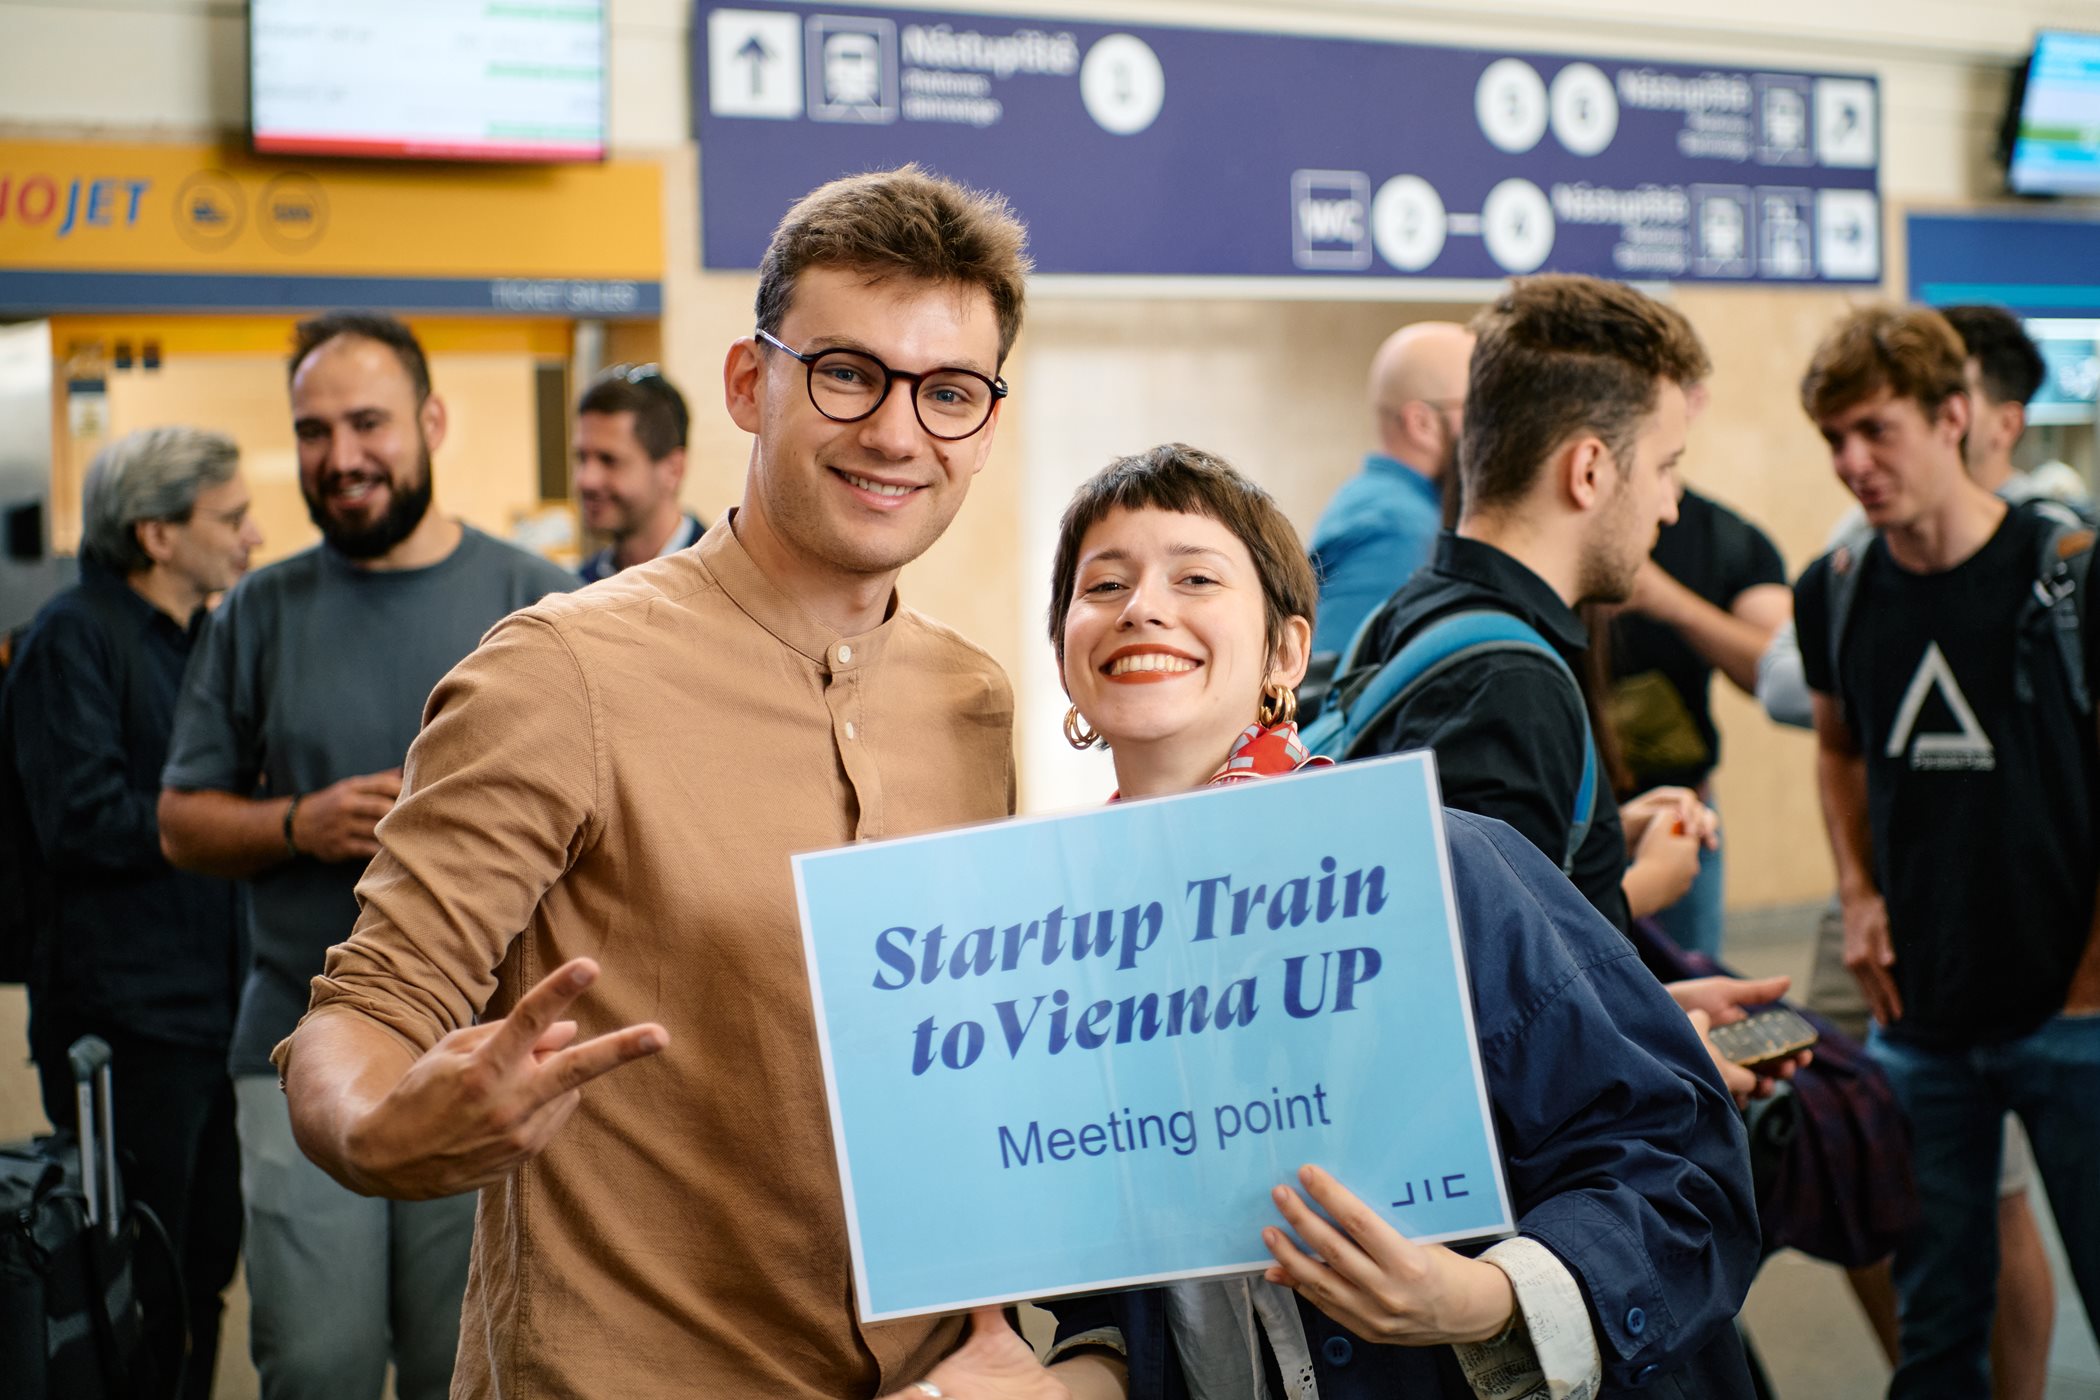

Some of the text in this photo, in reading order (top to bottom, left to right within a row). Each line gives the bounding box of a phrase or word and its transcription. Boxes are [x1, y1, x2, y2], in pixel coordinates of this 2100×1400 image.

[872, 855, 1389, 991] Startup Train
[1283, 946, 1383, 1019] UP
[997, 1082, 1333, 1169] Meeting point
